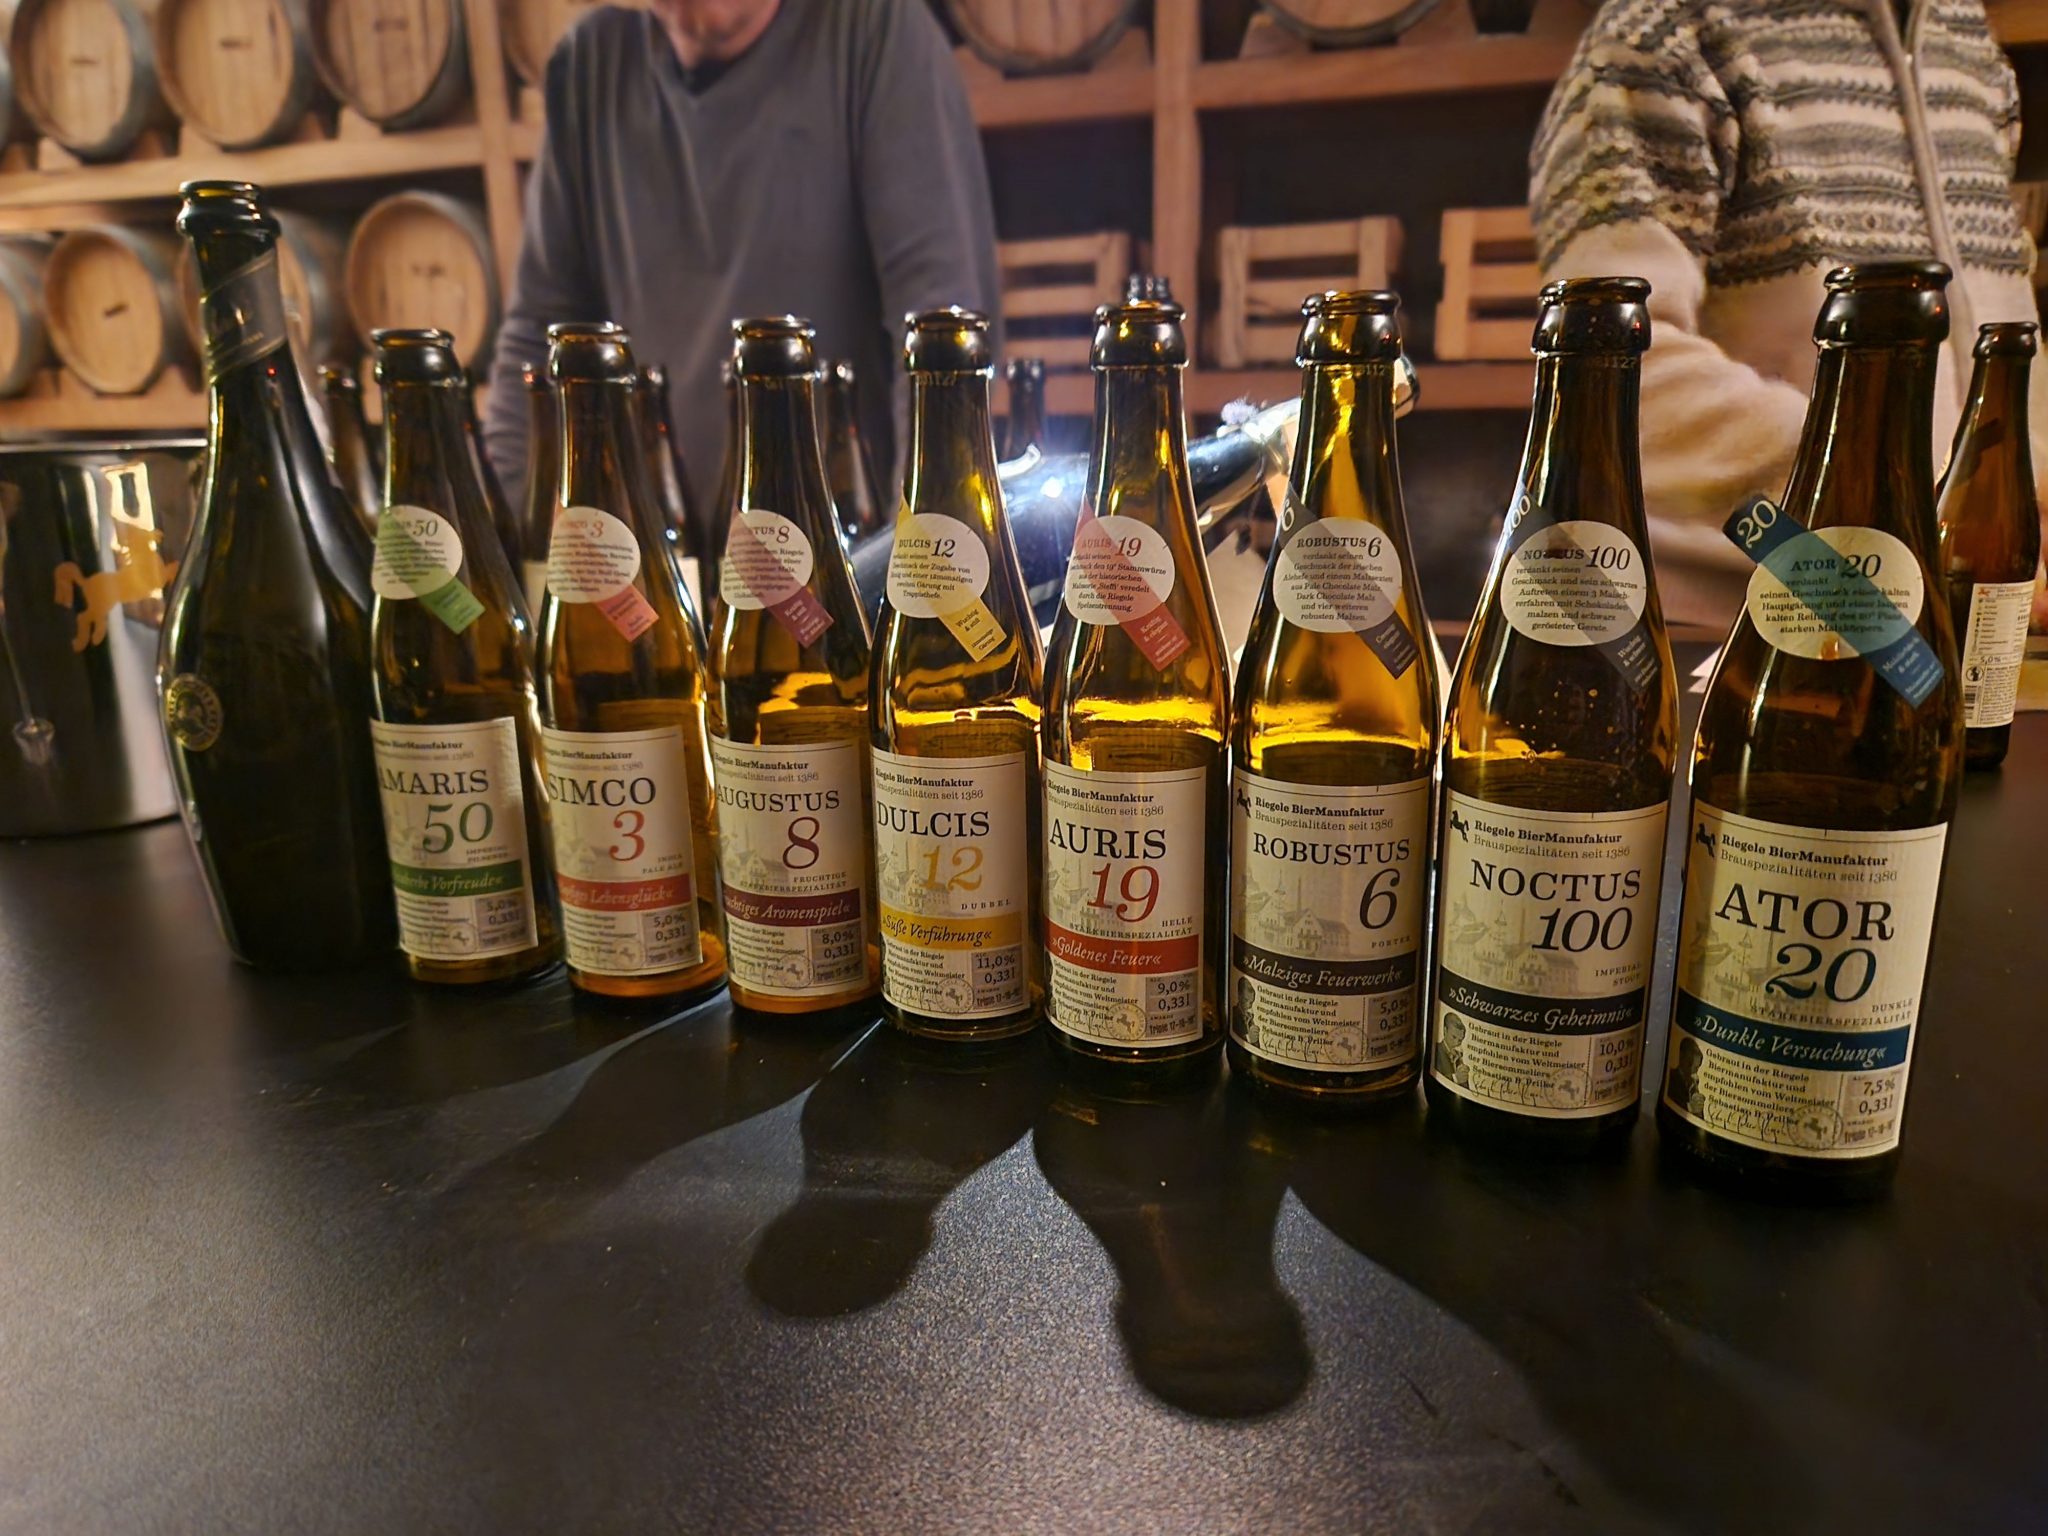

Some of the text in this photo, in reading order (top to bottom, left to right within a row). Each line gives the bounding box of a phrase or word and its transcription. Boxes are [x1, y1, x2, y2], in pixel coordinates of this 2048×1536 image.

[413, 520, 438, 537] 50
[590, 521, 604, 537] 3
[777, 526, 790, 543] 8
[1737, 500, 1777, 548] 20
[899, 539, 955, 557] DULCIS 12
[1115, 537, 1141, 556] 19
[1297, 537, 1382, 558] ROBUSTUS 6
[1586, 545, 1630, 570] 100
[1790, 554, 1882, 579] ATOR 20
[1118, 564, 1166, 575] Stammwürze
[1121, 585, 1150, 593] veredelt
[1512, 577, 1559, 585] Geschmack
[1561, 589, 1589, 597] einem
[1760, 591, 1790, 599] seinen
[1762, 603, 1822, 611] Hauptgärung
[1797, 614, 1835, 622] Reifung
[1780, 625, 1815, 633] starken
[735, 759, 808, 771] BierManufaktur
[778, 773, 819, 782] seit 1386
[897, 774, 974, 787] BierManufaktur
[548, 773, 656, 807] SIMCO
[718, 783, 840, 812] AUGUSTUS
[942, 791, 958, 799] seit
[961, 790, 983, 800] 1386
[1048, 780, 1154, 802] Riegele BierManufaktur
[1141, 806, 1163, 816] 1386
[1256, 797, 1384, 816] Riegele BierManufaktur
[422, 802, 493, 853] 50
[877, 801, 989, 837] DULCIS
[1256, 811, 1393, 831] Brauspezialitäten seit 1386
[610, 810, 645, 861] 3
[783, 816, 820, 869] 8
[1050, 818, 1166, 860] AURIS
[1475, 820, 1622, 844] Riegele BierManufaktur
[1254, 832, 1410, 865] ROBUSTUS
[1474, 835, 1630, 860] Brauspezialitäten seit 1386
[1721, 834, 1888, 867] Riegele BierManufaktur
[794, 872, 847, 882] FRUCHTIGE
[922, 845, 984, 892] 12
[1720, 849, 1897, 884] Brauspezialitäten seit 1386
[1470, 859, 1641, 902] NOCTUS
[1087, 863, 1159, 923] 19
[1360, 868, 1400, 929] 6
[762, 900, 850, 923] Aromenspiel«
[961, 899, 1010, 910] DUBBEL
[1715, 883, 1894, 941] ATOR
[1162, 917, 1192, 927] HELLE
[1532, 907, 1633, 953] 100
[911, 924, 992, 946] Verführung«
[921, 951, 945, 959] Riegele
[1110, 950, 1161, 966] Feuer«
[924, 969, 965, 978] Weltmeister
[1091, 973, 1117, 984] Riegele
[1595, 962, 1641, 977] IMPERIAL
[1766, 943, 1877, 1002] 20
[1613, 974, 1640, 987] STOUT
[1095, 993, 1138, 1004] Weltmeister
[1260, 996, 1336, 1017] Biermanufaktur und
[1309, 998, 1338, 1007] Riegele
[1872, 999, 1912, 1013] DUNKLE
[1257, 1006, 1360, 1026] empfohlen Weltmeister
[1750, 1005, 1911, 1026] STARKBIERSPEZIALITÄT
[1270, 1018, 1329, 1036] Biersommeliers
[1468, 1022, 1562, 1048] Gebraut der Riegele
[1471, 1034, 1540, 1056] Biermanufaktur
[1770, 1036, 1887, 1068] Versuchung«
[1467, 1044, 1585, 1070] empfohlen vom Weltmeister
[1482, 1058, 1549, 1077] Biersommeliers
[1705, 1049, 1809, 1082] Gebraut der Riegele
[1473, 1065, 1513, 1084] Sebastian
[1708, 1062, 1806, 1092] Biermanufaktur und
[1703, 1072, 1835, 1107] empfohlen vom Weltmeister
[1709, 1095, 1751, 1116] Sebastian
[1719, 1089, 1795, 1114] Biersommeliers
